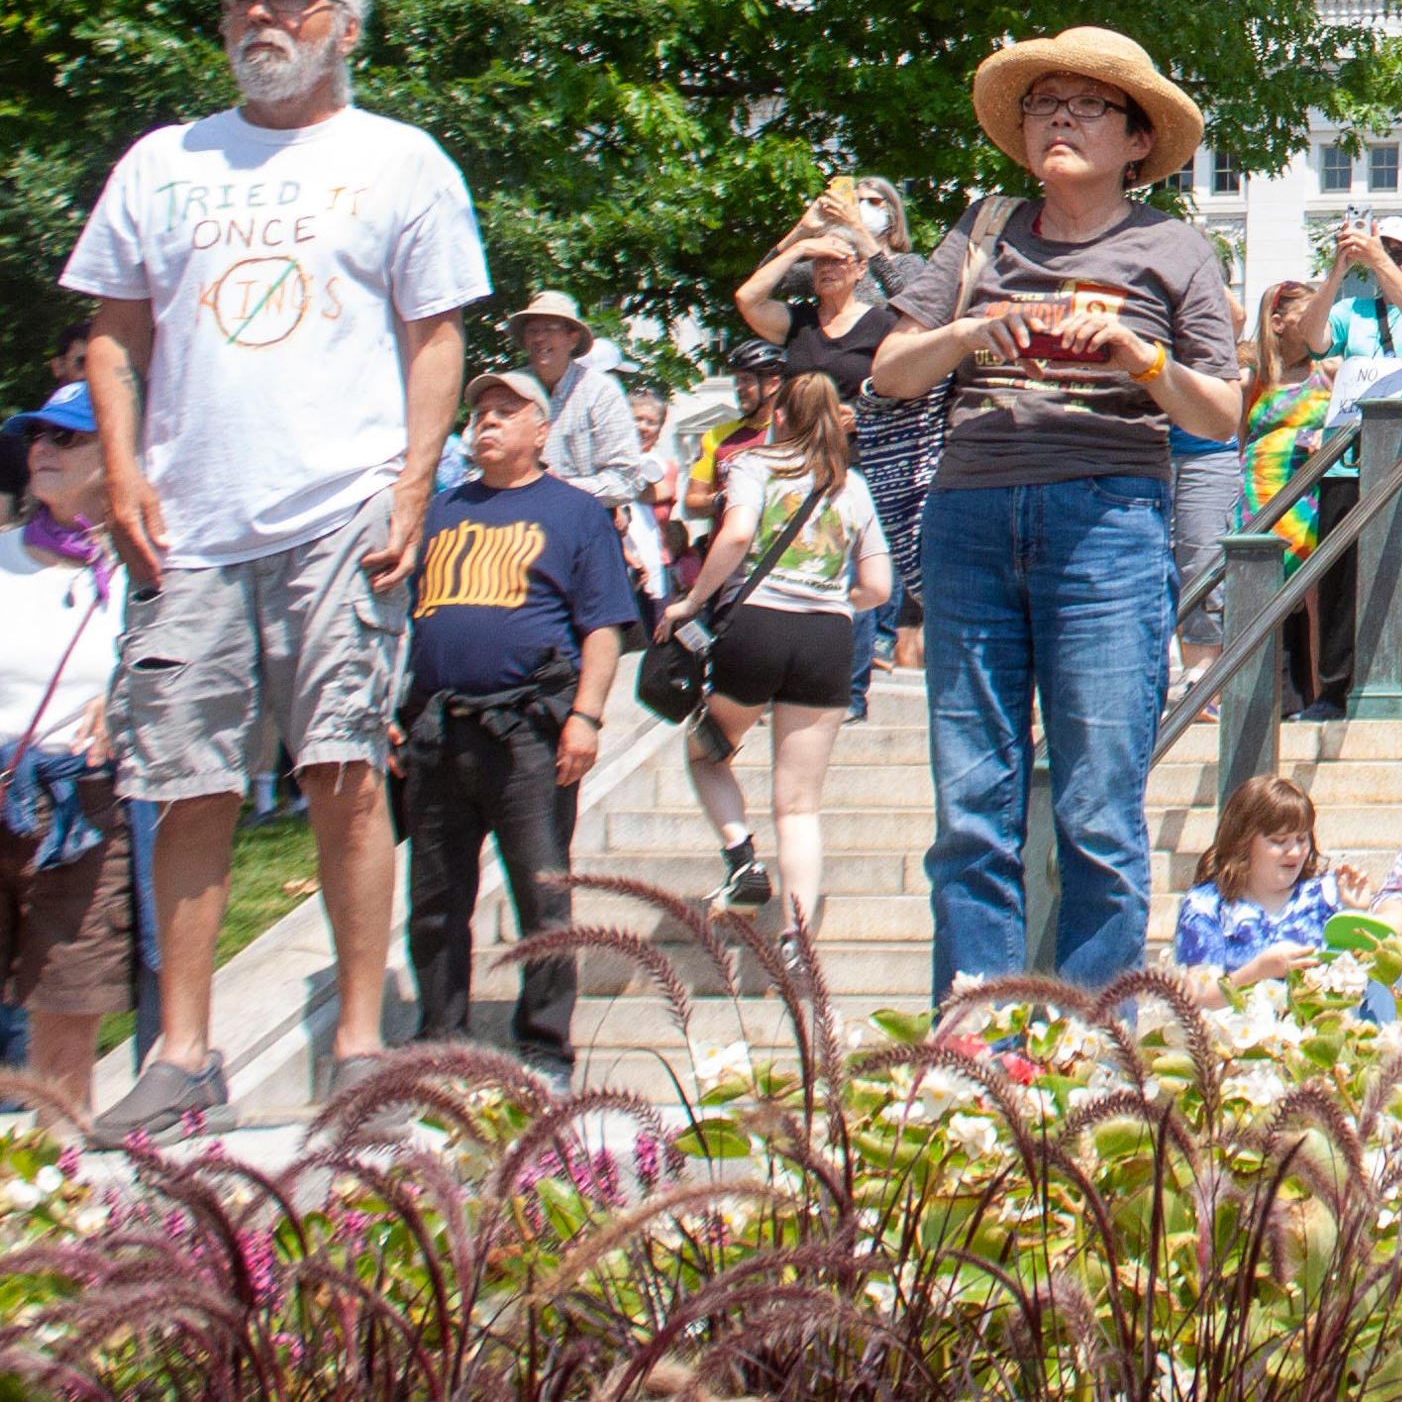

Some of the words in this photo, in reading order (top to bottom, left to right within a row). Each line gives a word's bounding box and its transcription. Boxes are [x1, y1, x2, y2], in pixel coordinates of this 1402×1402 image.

[154, 180, 301, 231] TRIED
[325, 186, 369, 216] IT
[192, 215, 317, 250] ONCE
[195, 273, 344, 327] KINGS
[1357, 368, 1378, 382] NO
